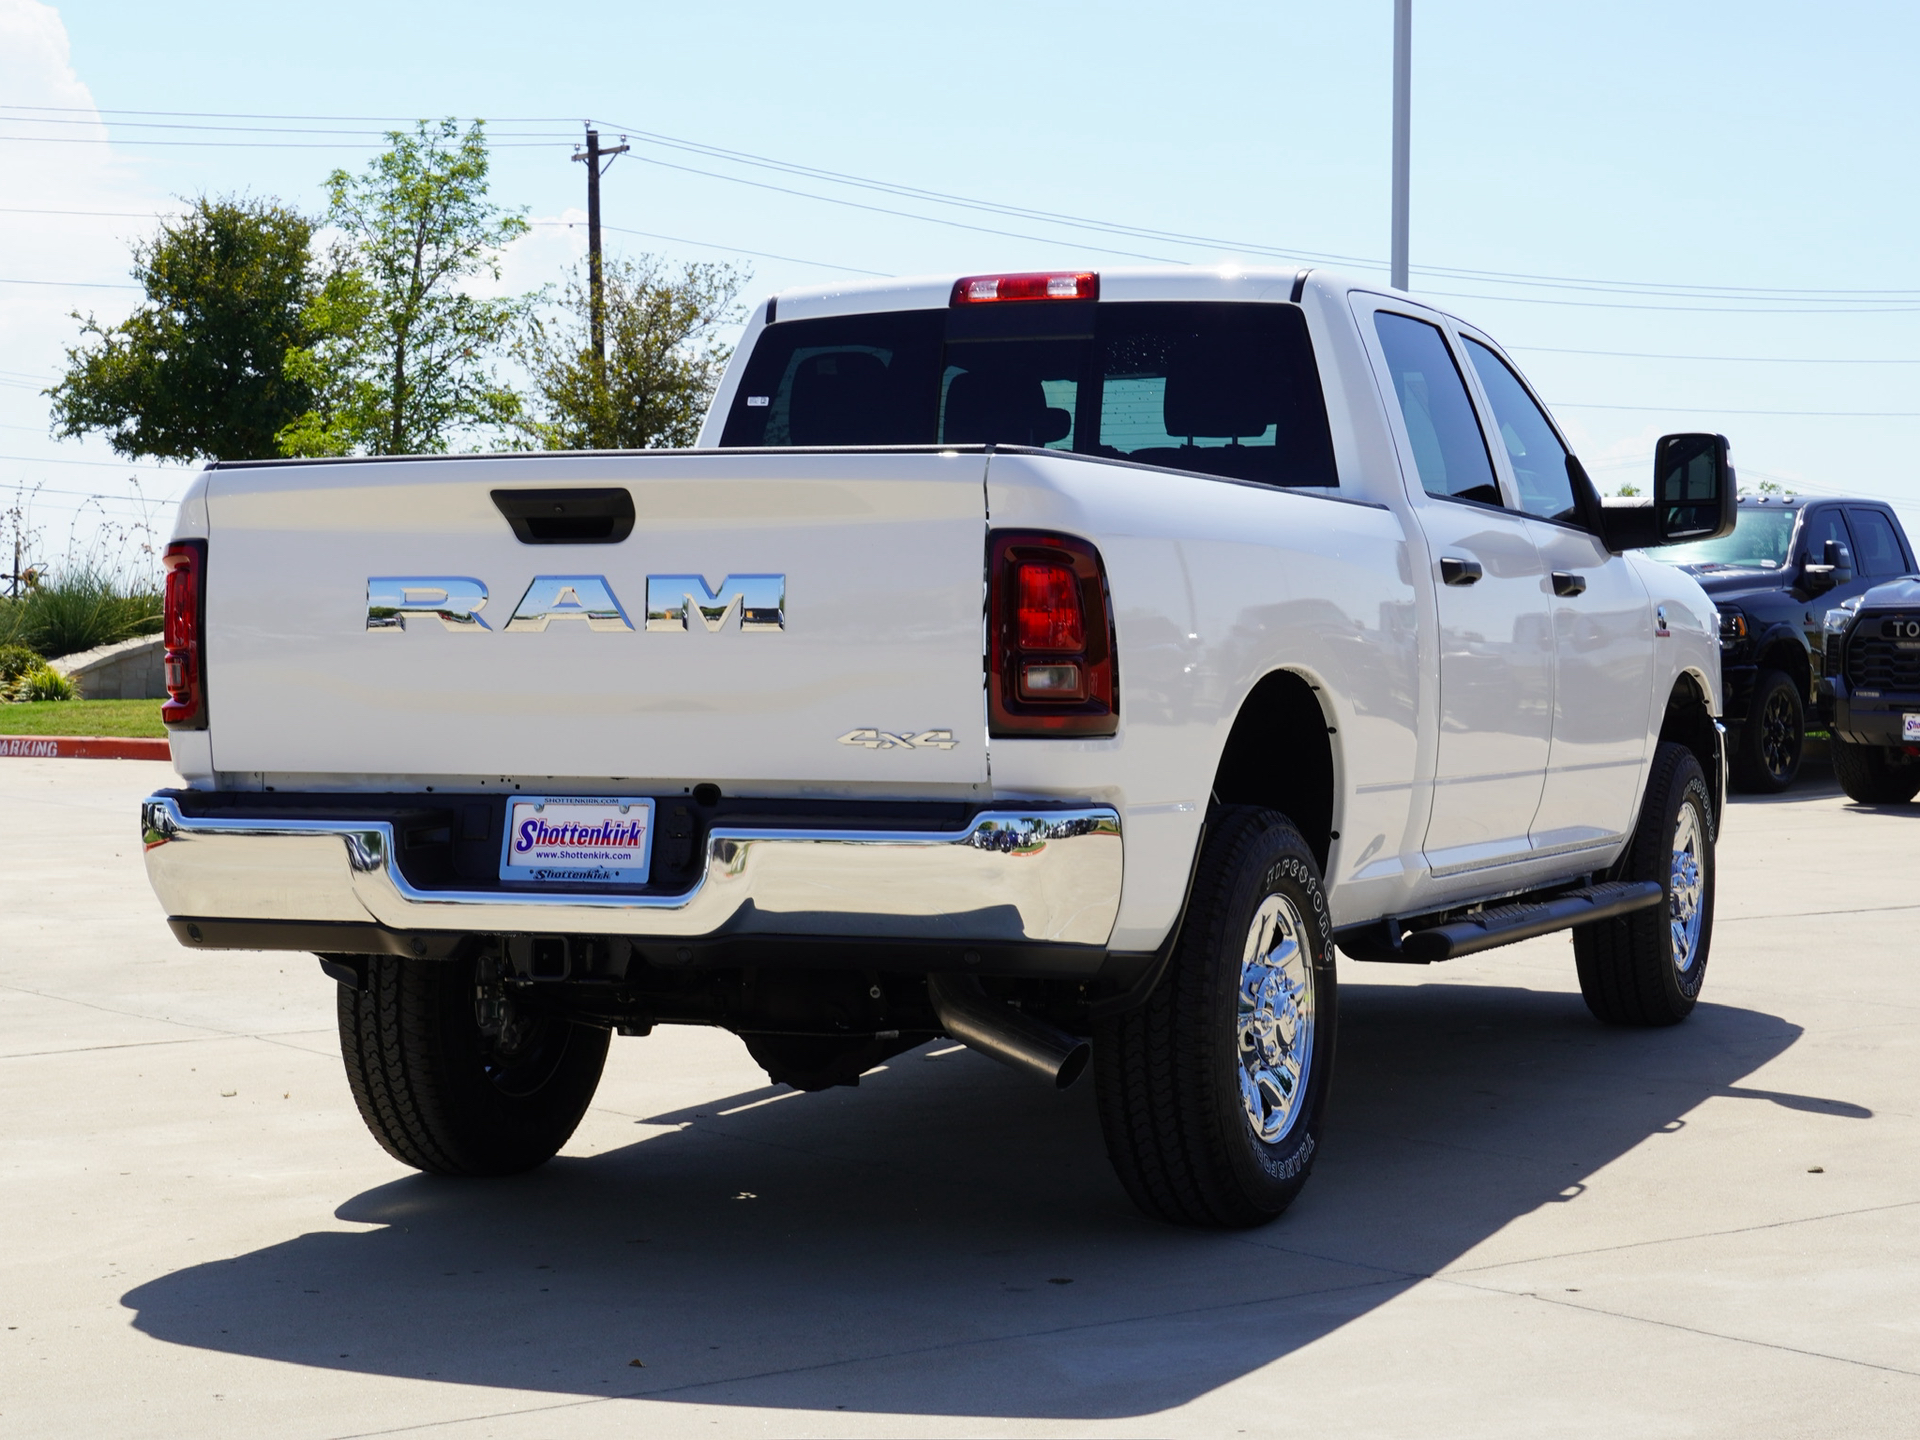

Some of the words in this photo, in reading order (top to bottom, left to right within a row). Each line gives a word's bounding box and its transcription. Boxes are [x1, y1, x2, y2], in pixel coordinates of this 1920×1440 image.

[367, 574, 787, 632] RAM
[1892, 621, 1920, 637] TO
[837, 728, 960, 750] 4x4
[544, 797, 619, 805] SHOTTENKIRK.COM
[516, 819, 643, 852] Shottenkirk
[536, 851, 632, 860] www.Shottenkirk.com
[533, 868, 611, 880] Shottenkirk
